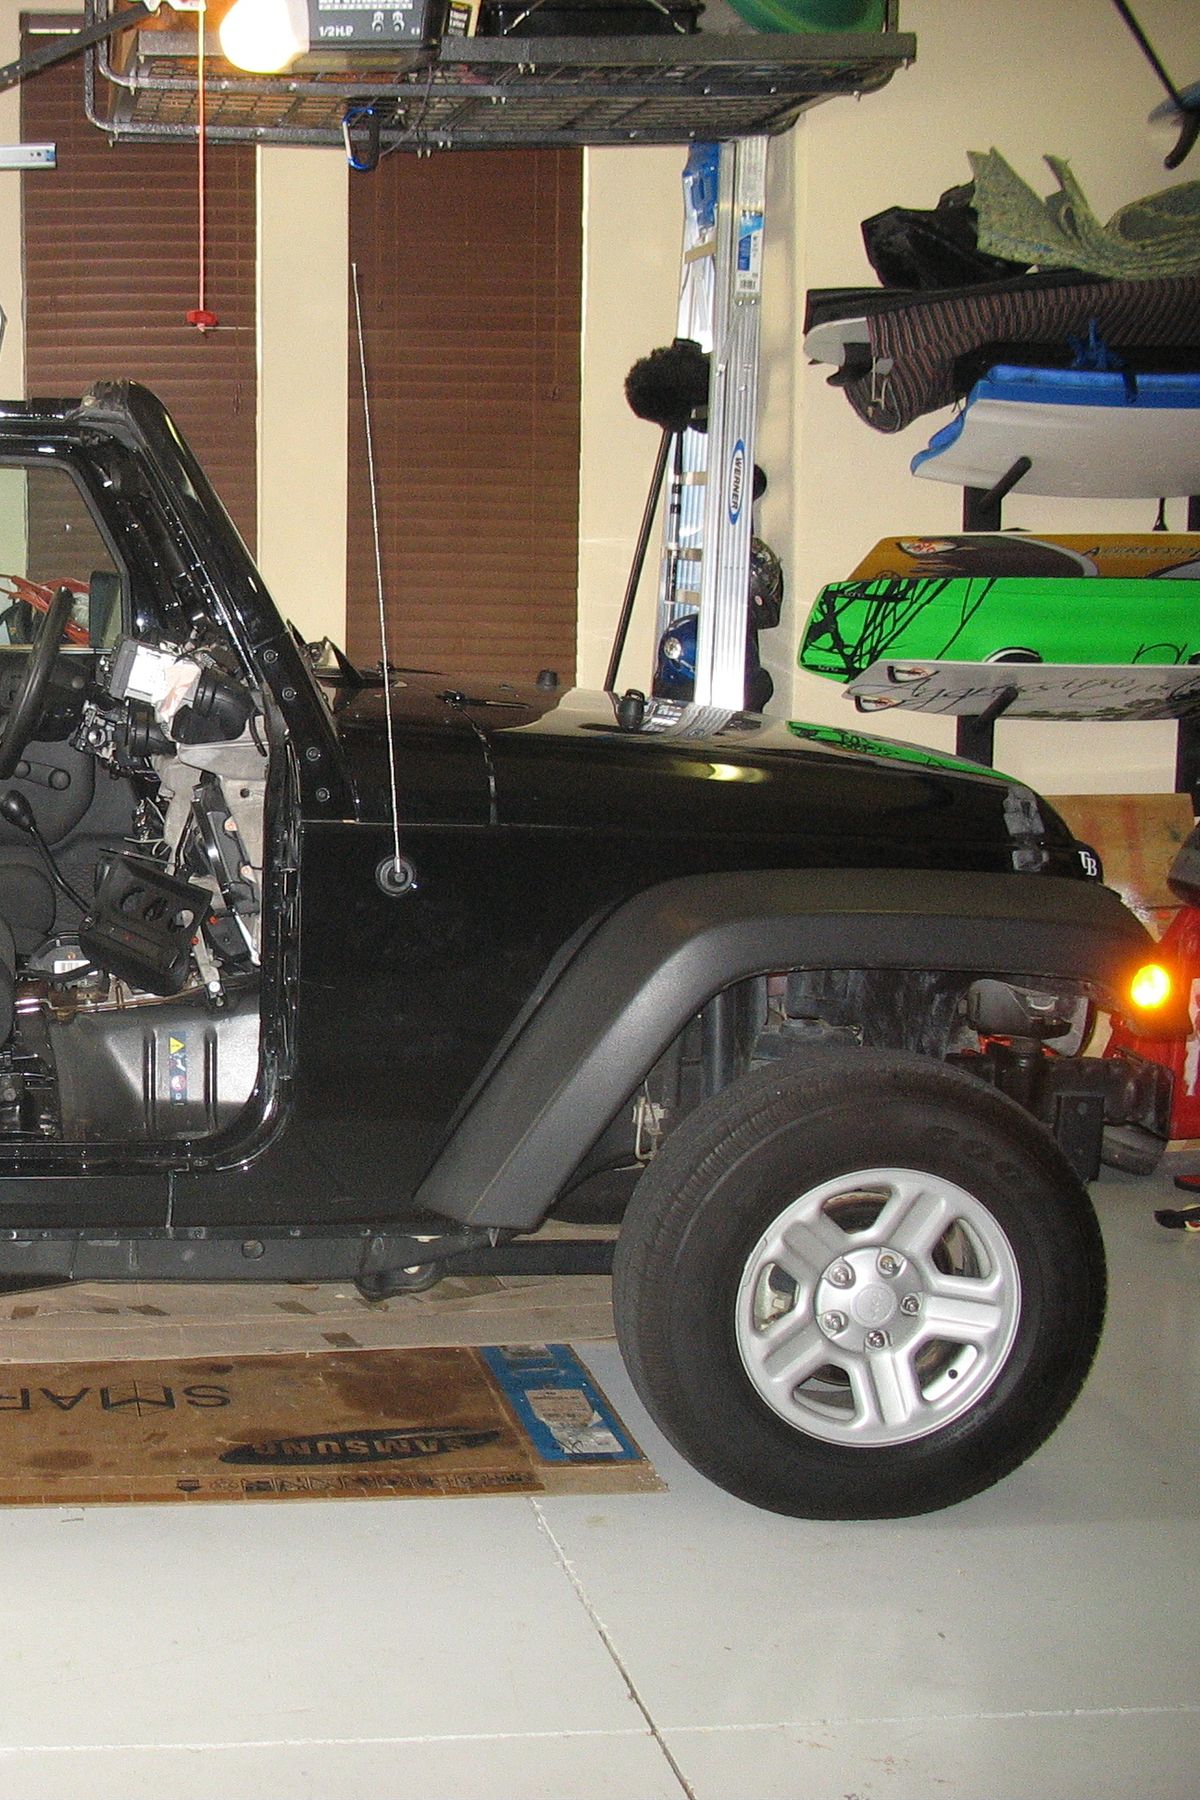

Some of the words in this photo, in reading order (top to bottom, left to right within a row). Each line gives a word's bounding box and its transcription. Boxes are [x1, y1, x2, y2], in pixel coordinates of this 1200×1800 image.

[731, 457, 743, 510] WERNER
[1078, 850, 1098, 877] TB
[252, 1437, 464, 1459] SAMSUNG
